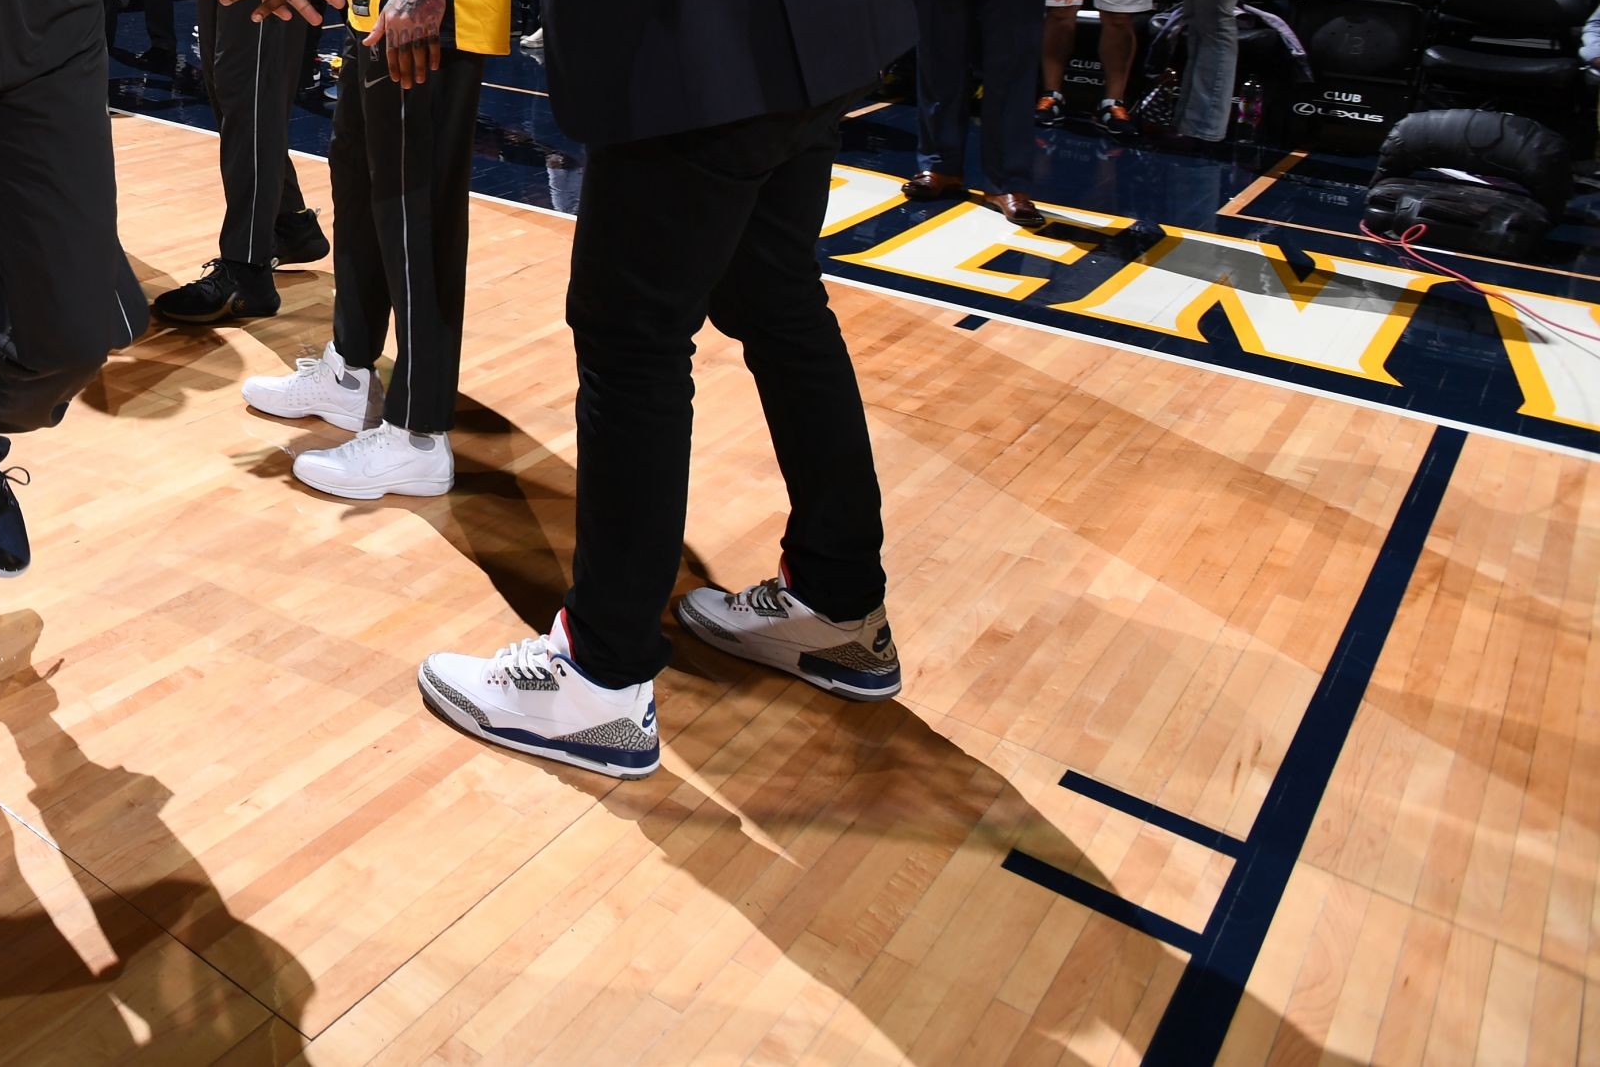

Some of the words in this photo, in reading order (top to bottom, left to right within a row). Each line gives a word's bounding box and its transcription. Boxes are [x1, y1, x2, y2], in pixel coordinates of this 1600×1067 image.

[1069, 59, 1102, 71] CLUB
[1064, 74, 1106, 87] LEXU
[1323, 91, 1363, 107] CLUB
[1317, 108, 1385, 124] LEXUS
